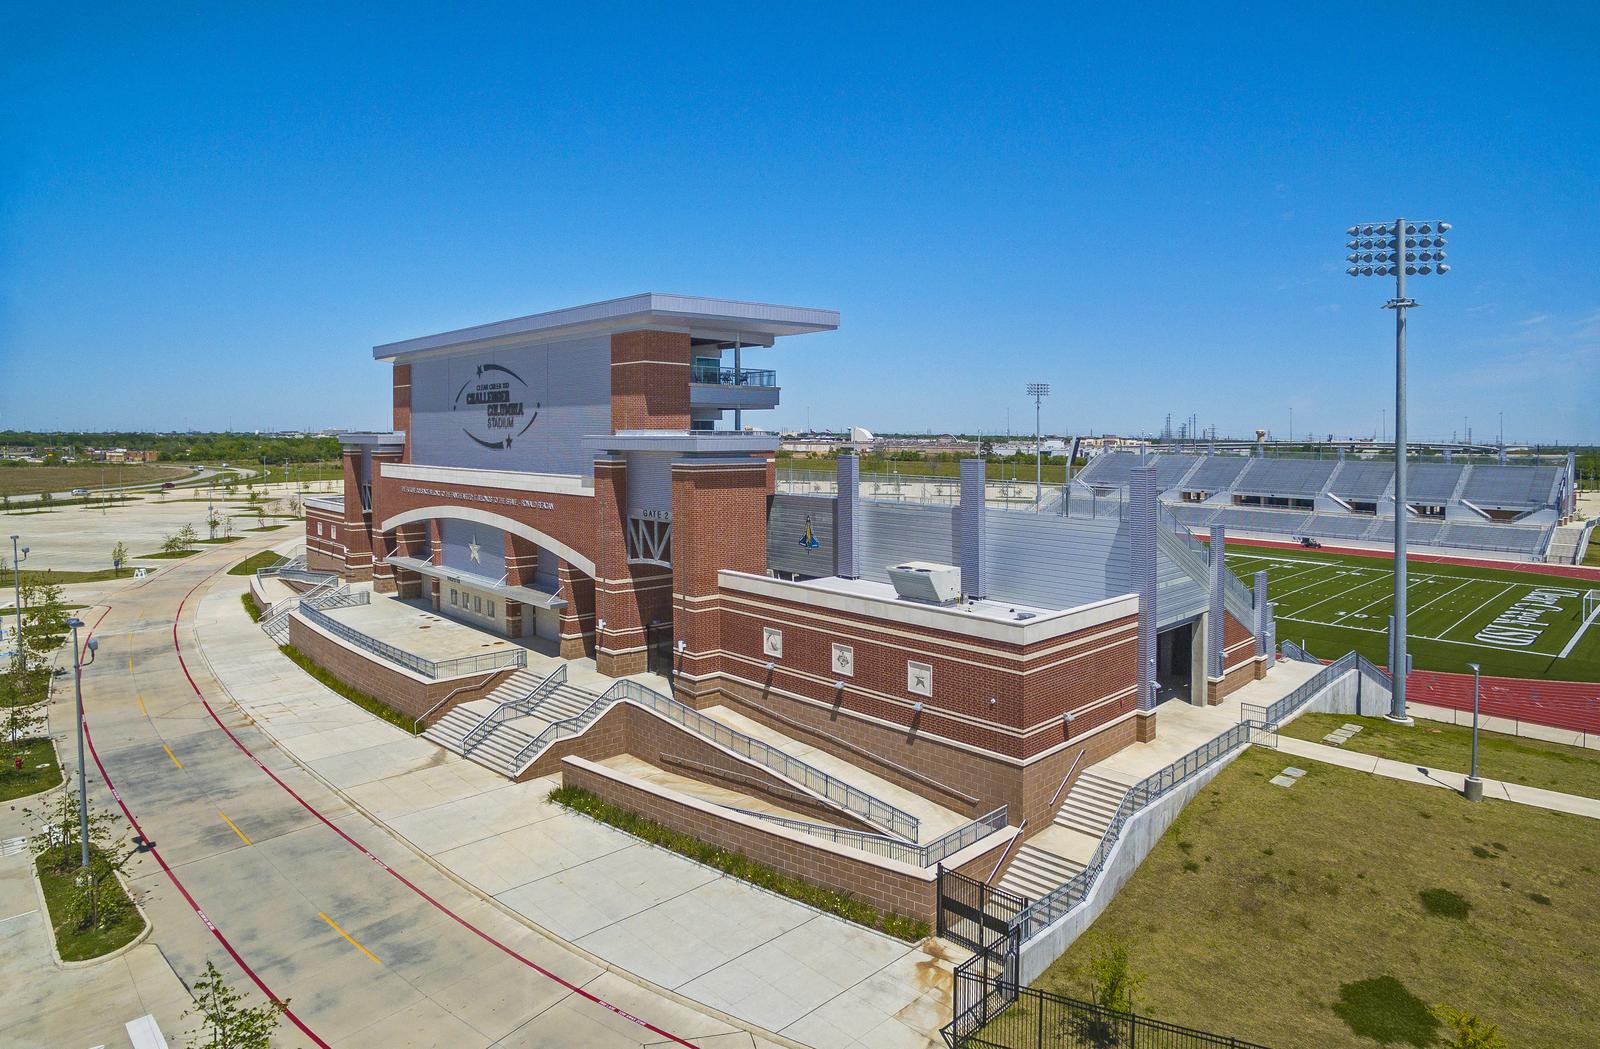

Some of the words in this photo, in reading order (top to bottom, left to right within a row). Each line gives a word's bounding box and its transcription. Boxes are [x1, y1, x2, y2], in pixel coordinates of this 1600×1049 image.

[466, 391, 510, 404] CHALLENGER
[487, 402, 524, 417] COLUMBIA
[487, 417, 514, 429] STADIUM
[643, 510, 661, 519] GATE
[1474, 623, 1544, 646] ISD
